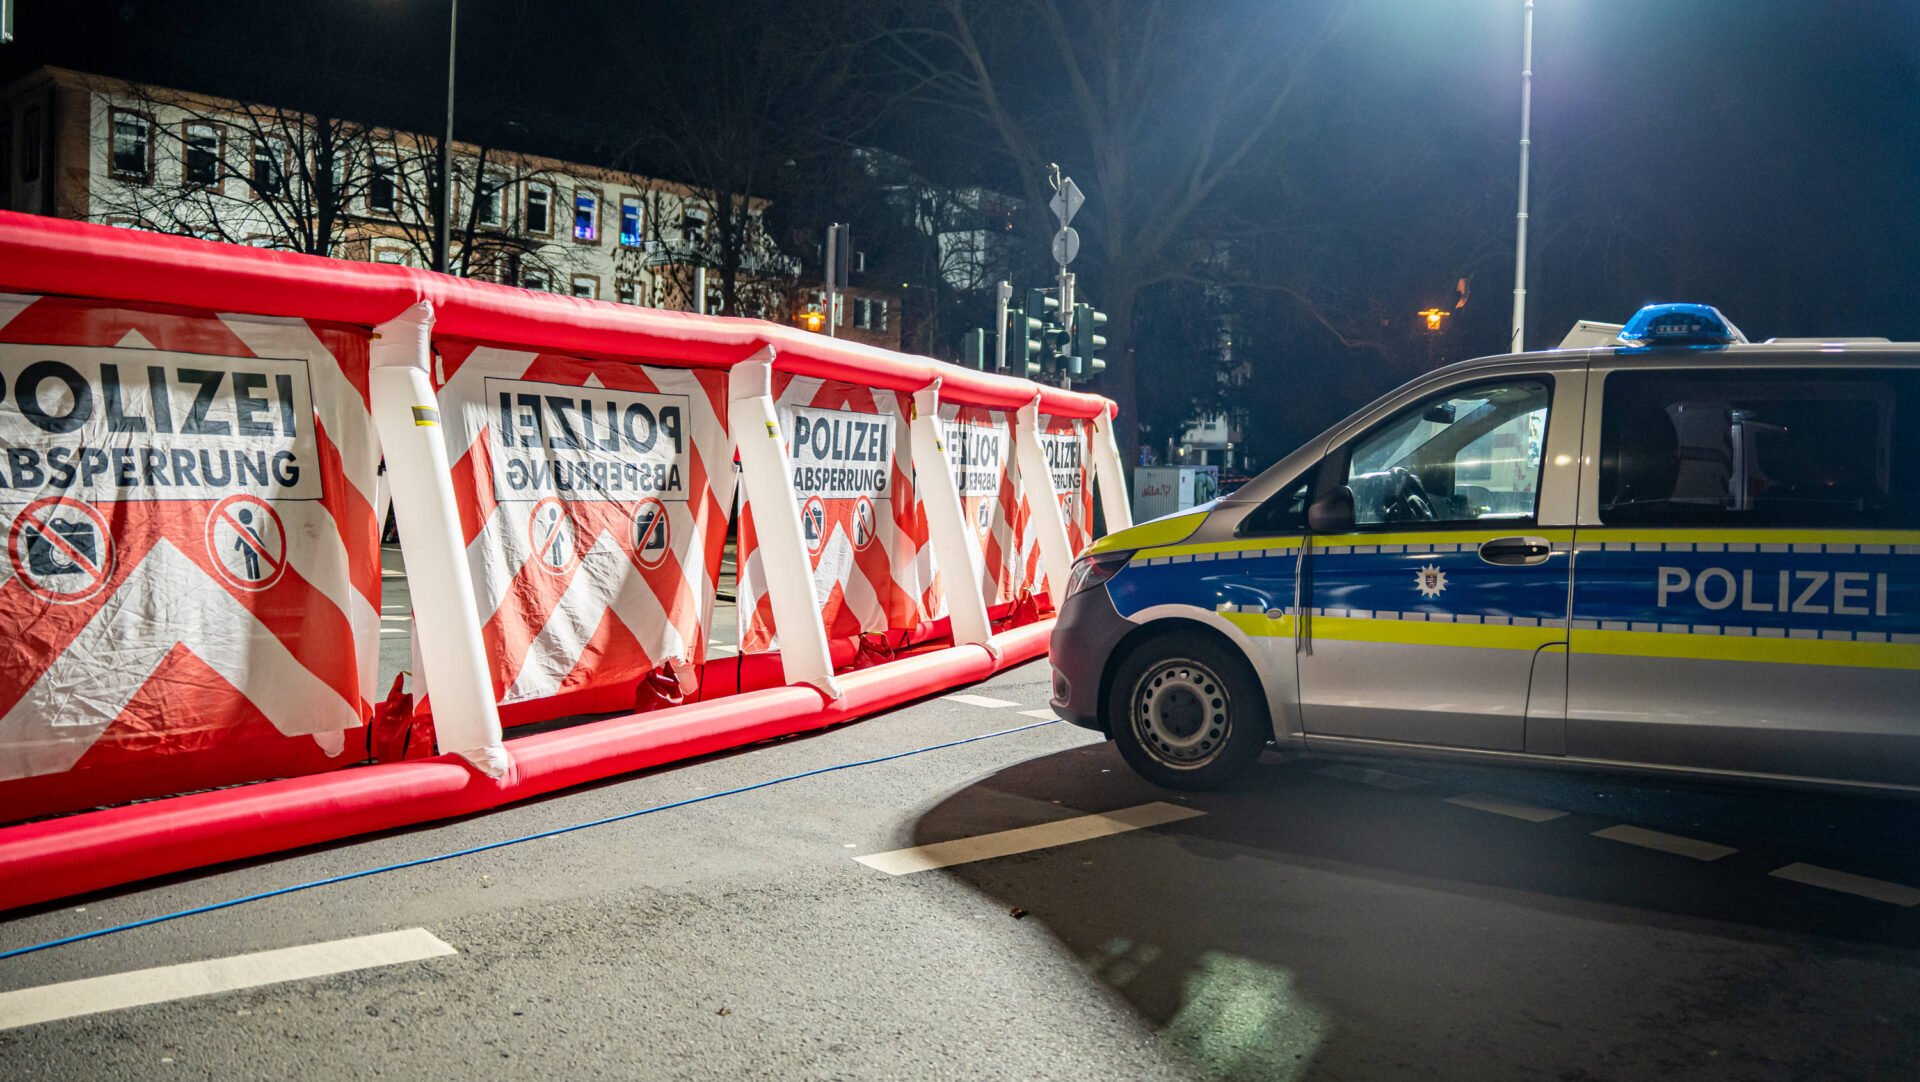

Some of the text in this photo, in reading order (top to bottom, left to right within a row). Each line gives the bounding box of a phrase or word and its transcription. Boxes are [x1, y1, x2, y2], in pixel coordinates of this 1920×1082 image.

[0, 360, 297, 438] OLIZEI
[793, 415, 887, 462] POLIZEI
[793, 467, 887, 492] ABSPERRUNG
[1657, 566, 1888, 617] POLIZEI
